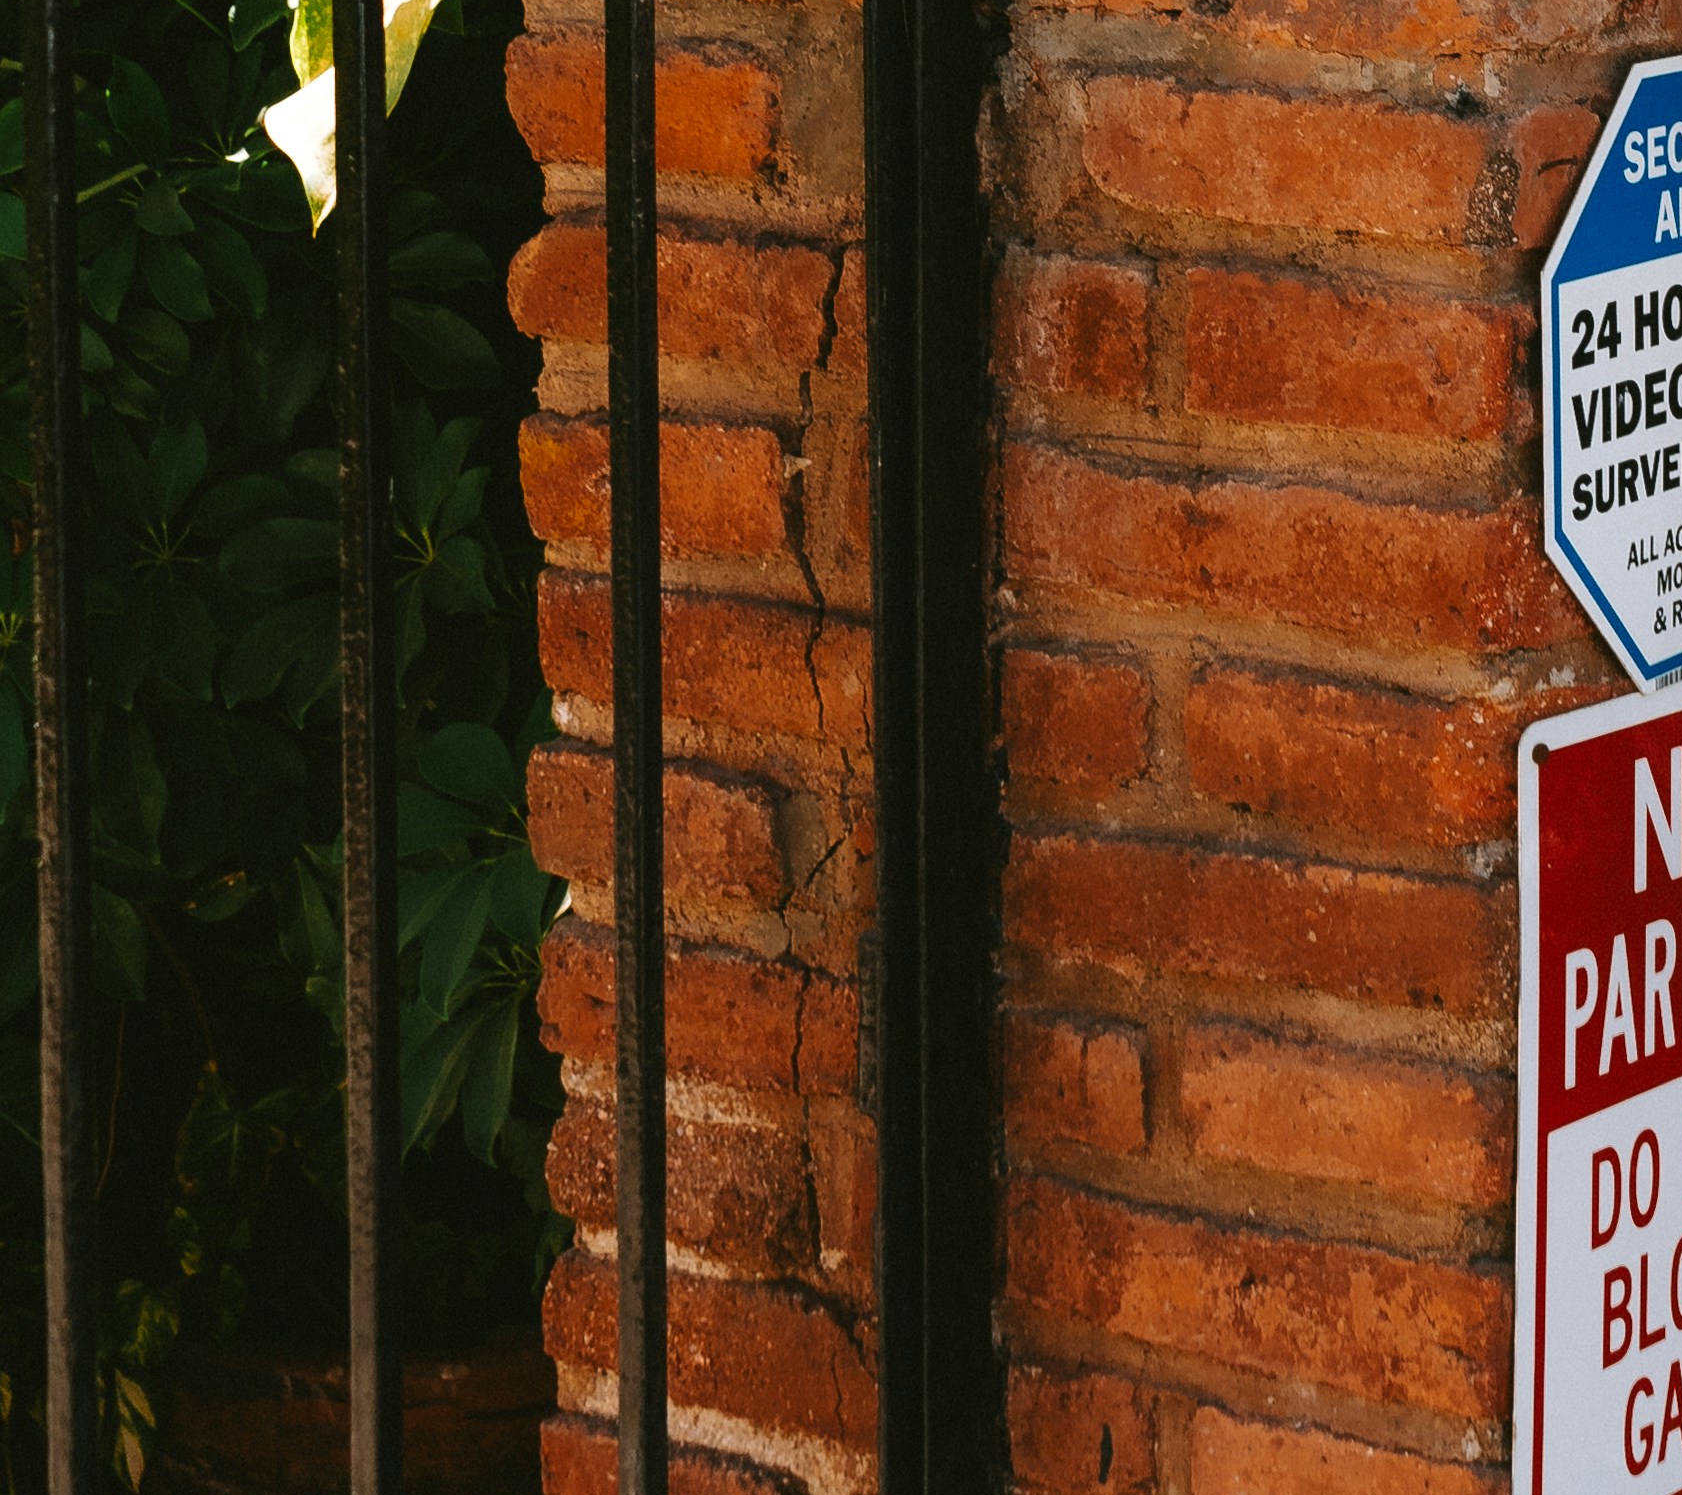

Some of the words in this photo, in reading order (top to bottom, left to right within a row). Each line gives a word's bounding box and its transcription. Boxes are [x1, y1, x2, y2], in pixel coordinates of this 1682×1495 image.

[1571, 301, 1621, 371] 24
[1627, 535, 1659, 570] ALL
[1653, 607, 1667, 634] &
[1591, 1128, 1660, 1250] DO
